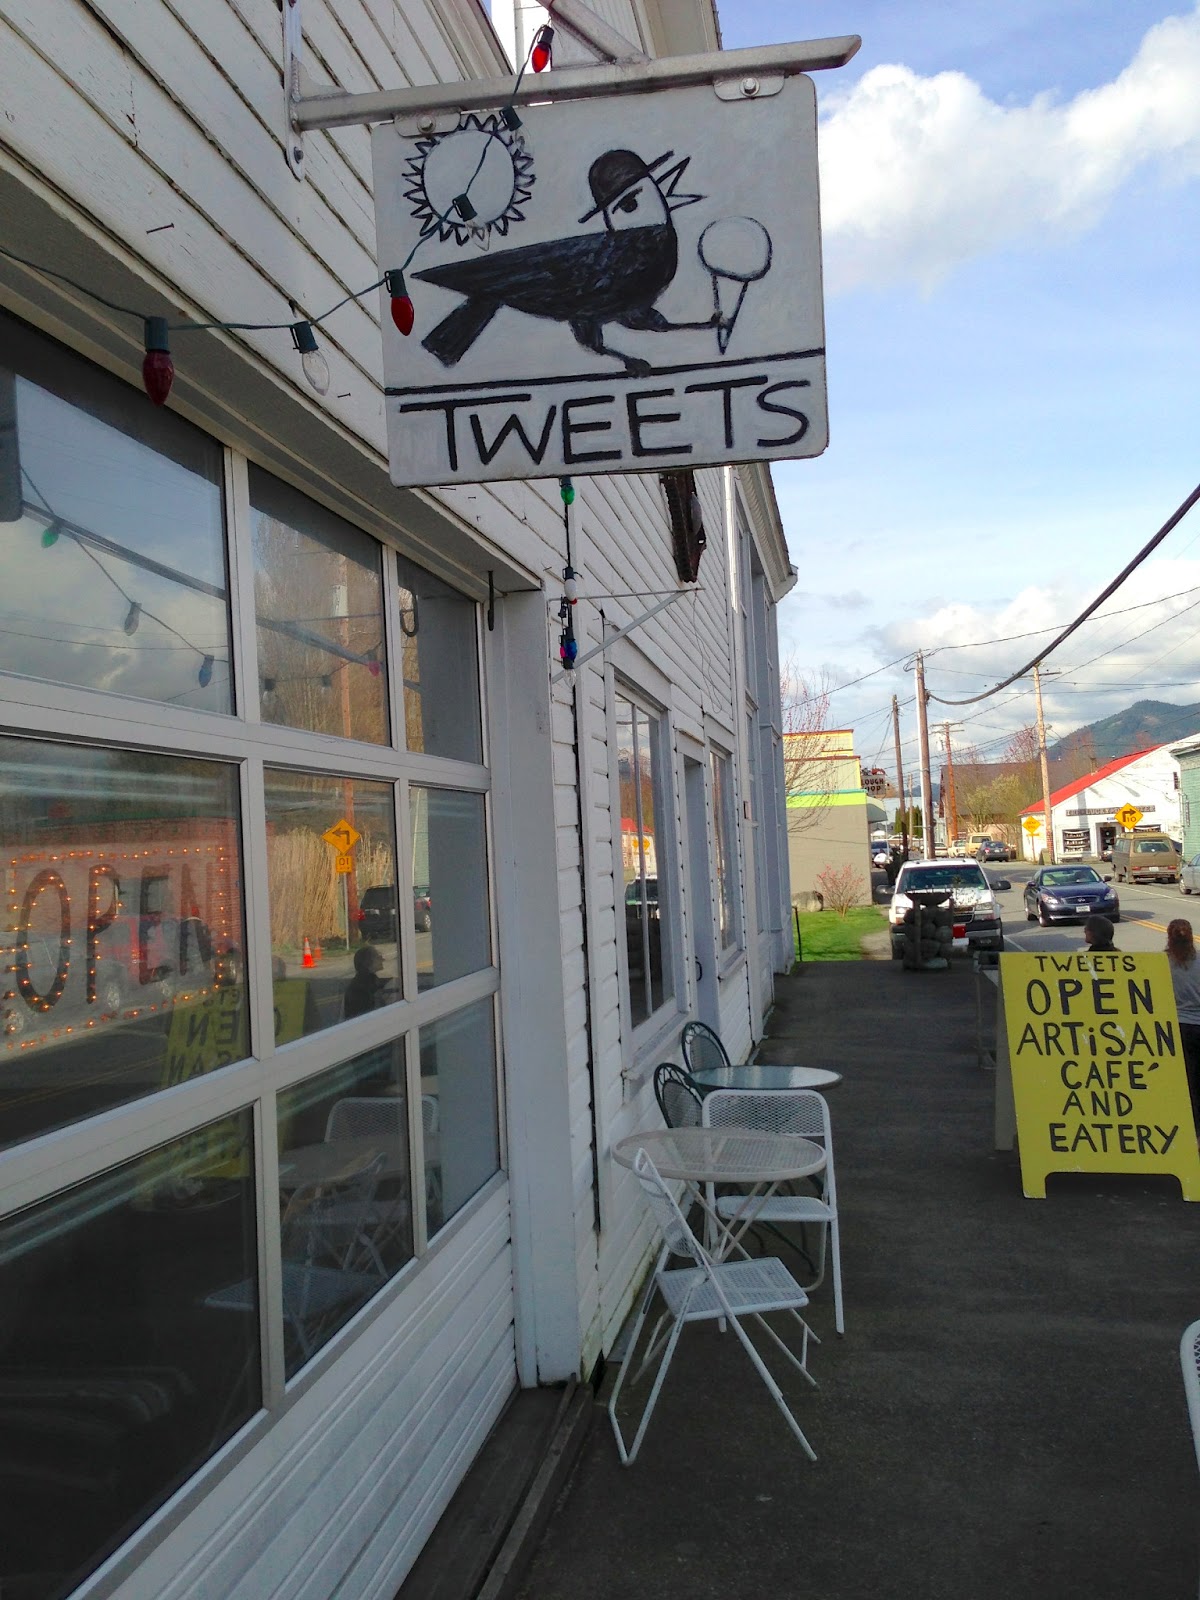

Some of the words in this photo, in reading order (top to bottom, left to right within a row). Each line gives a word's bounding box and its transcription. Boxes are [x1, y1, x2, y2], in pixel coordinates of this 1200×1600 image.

[400, 376, 811, 472] TWEETS
[15, 862, 214, 1013] OPEN
[1034, 955, 1137, 973] TWEETS
[1026, 978, 1154, 1015] OPEN
[1062, 1090, 1133, 1117] AND
[1049, 1123, 1179, 1155] EATERY
